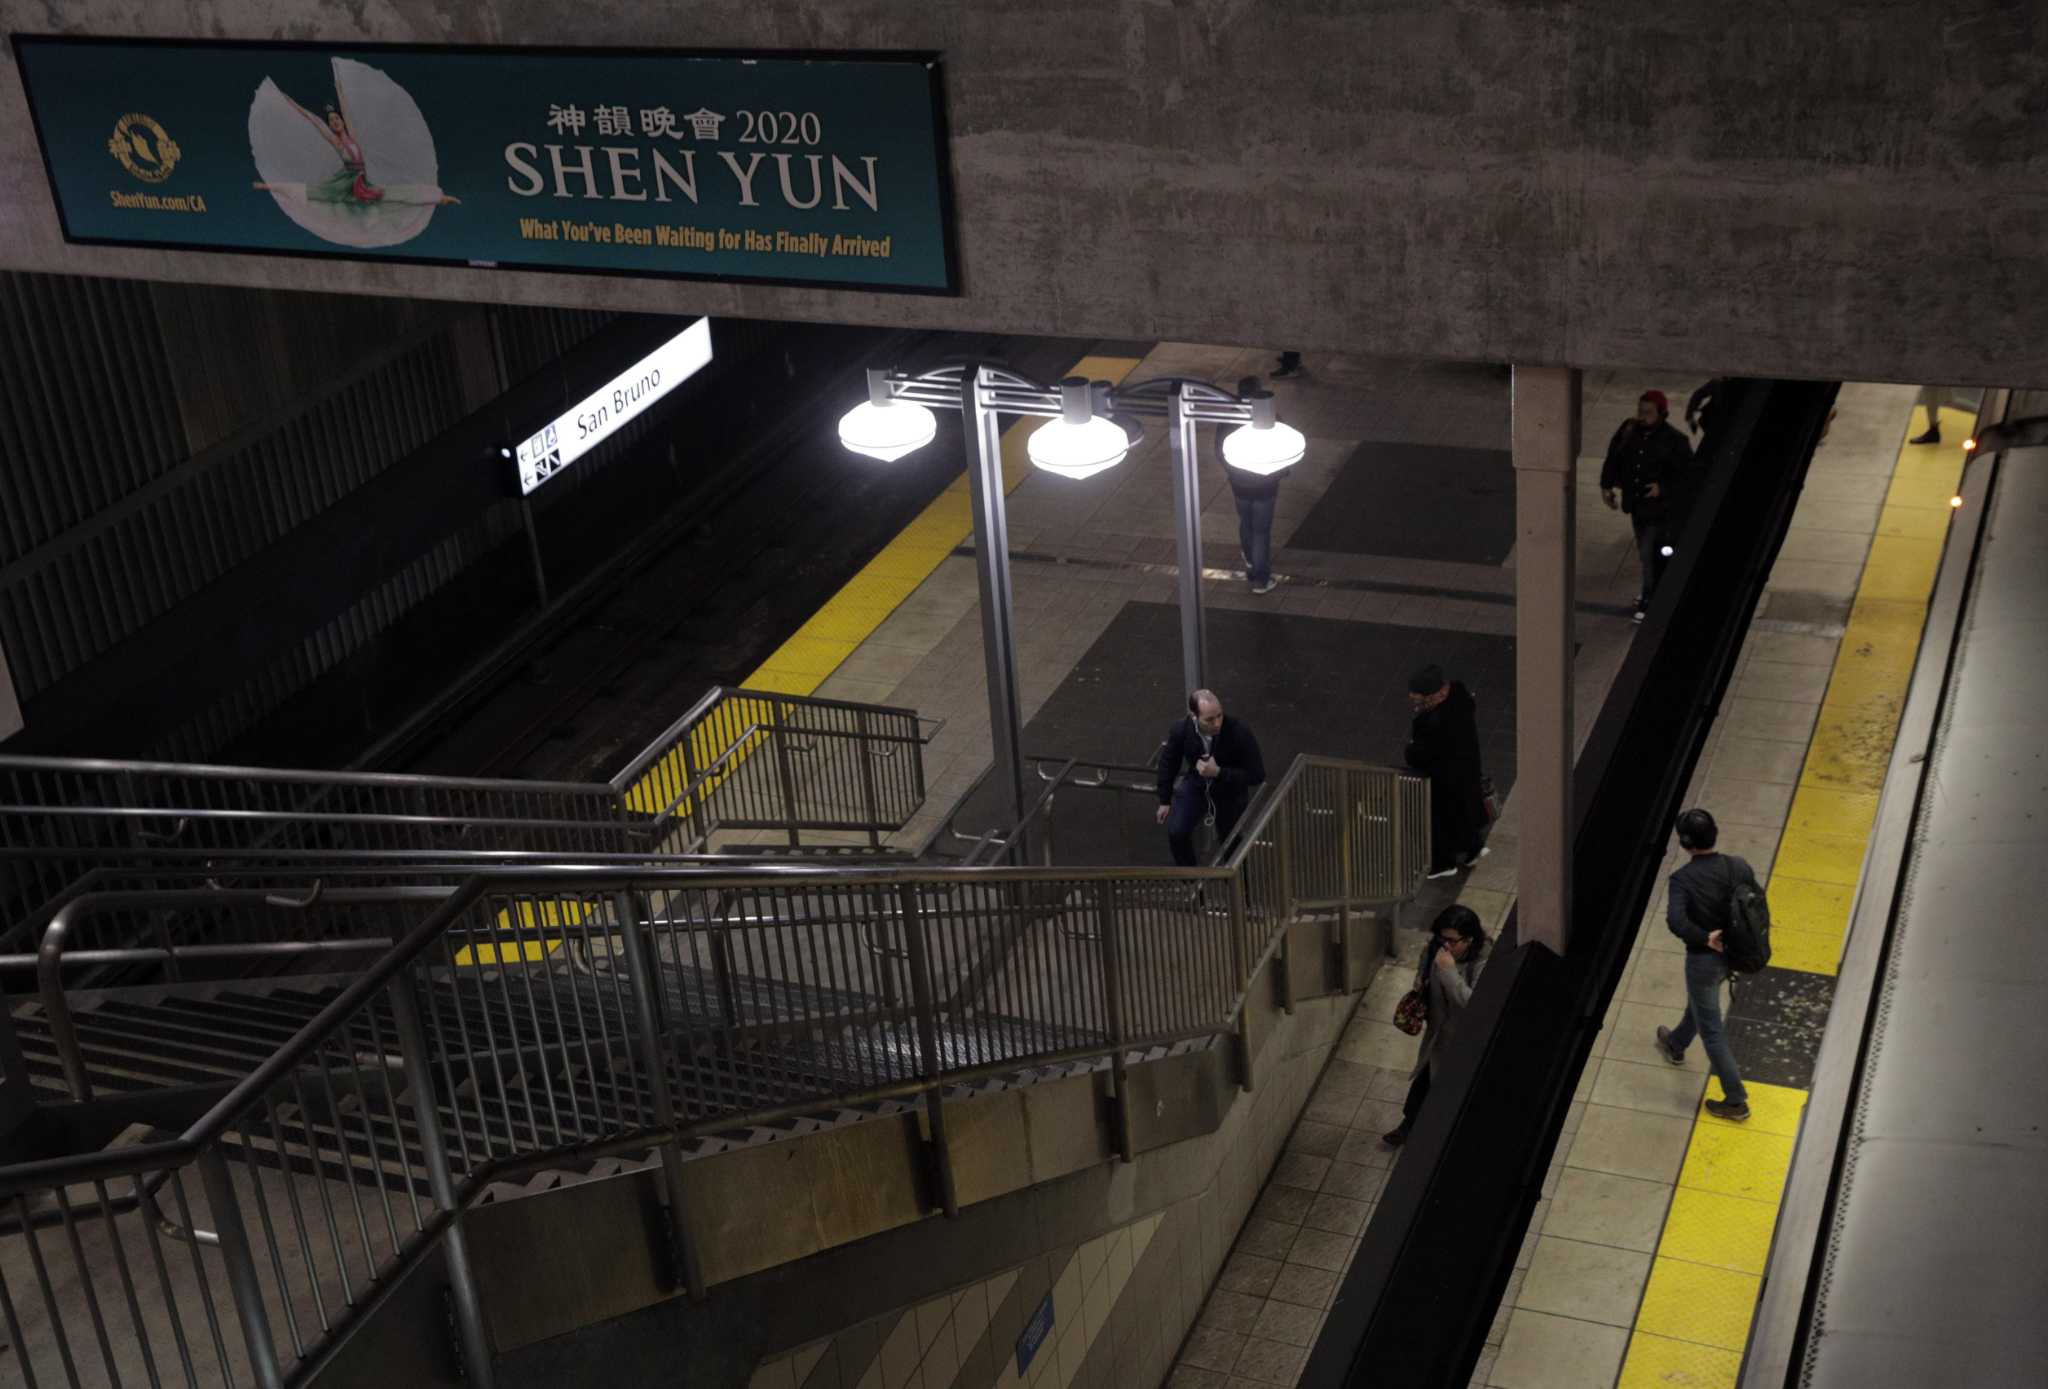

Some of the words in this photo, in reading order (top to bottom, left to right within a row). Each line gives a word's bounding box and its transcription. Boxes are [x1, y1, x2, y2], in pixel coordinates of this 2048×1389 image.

[547, 103, 726, 141] 神韻晚會
[736, 110, 822, 145] 2020
[504, 142, 698, 204] SHEN
[717, 151, 878, 212] YUN
[111, 191, 207, 212] ShenYun.com/CA
[520, 217, 559, 240] What
[561, 220, 612, 243] You've
[615, 223, 652, 245] Been
[655, 225, 714, 251] Waiting
[718, 228, 741, 249] for
[744, 229, 773, 251] Has
[776, 231, 828, 257] Finally
[831, 234, 892, 257] Arrived
[577, 406, 608, 439] San
[613, 369, 660, 414] Bruno
